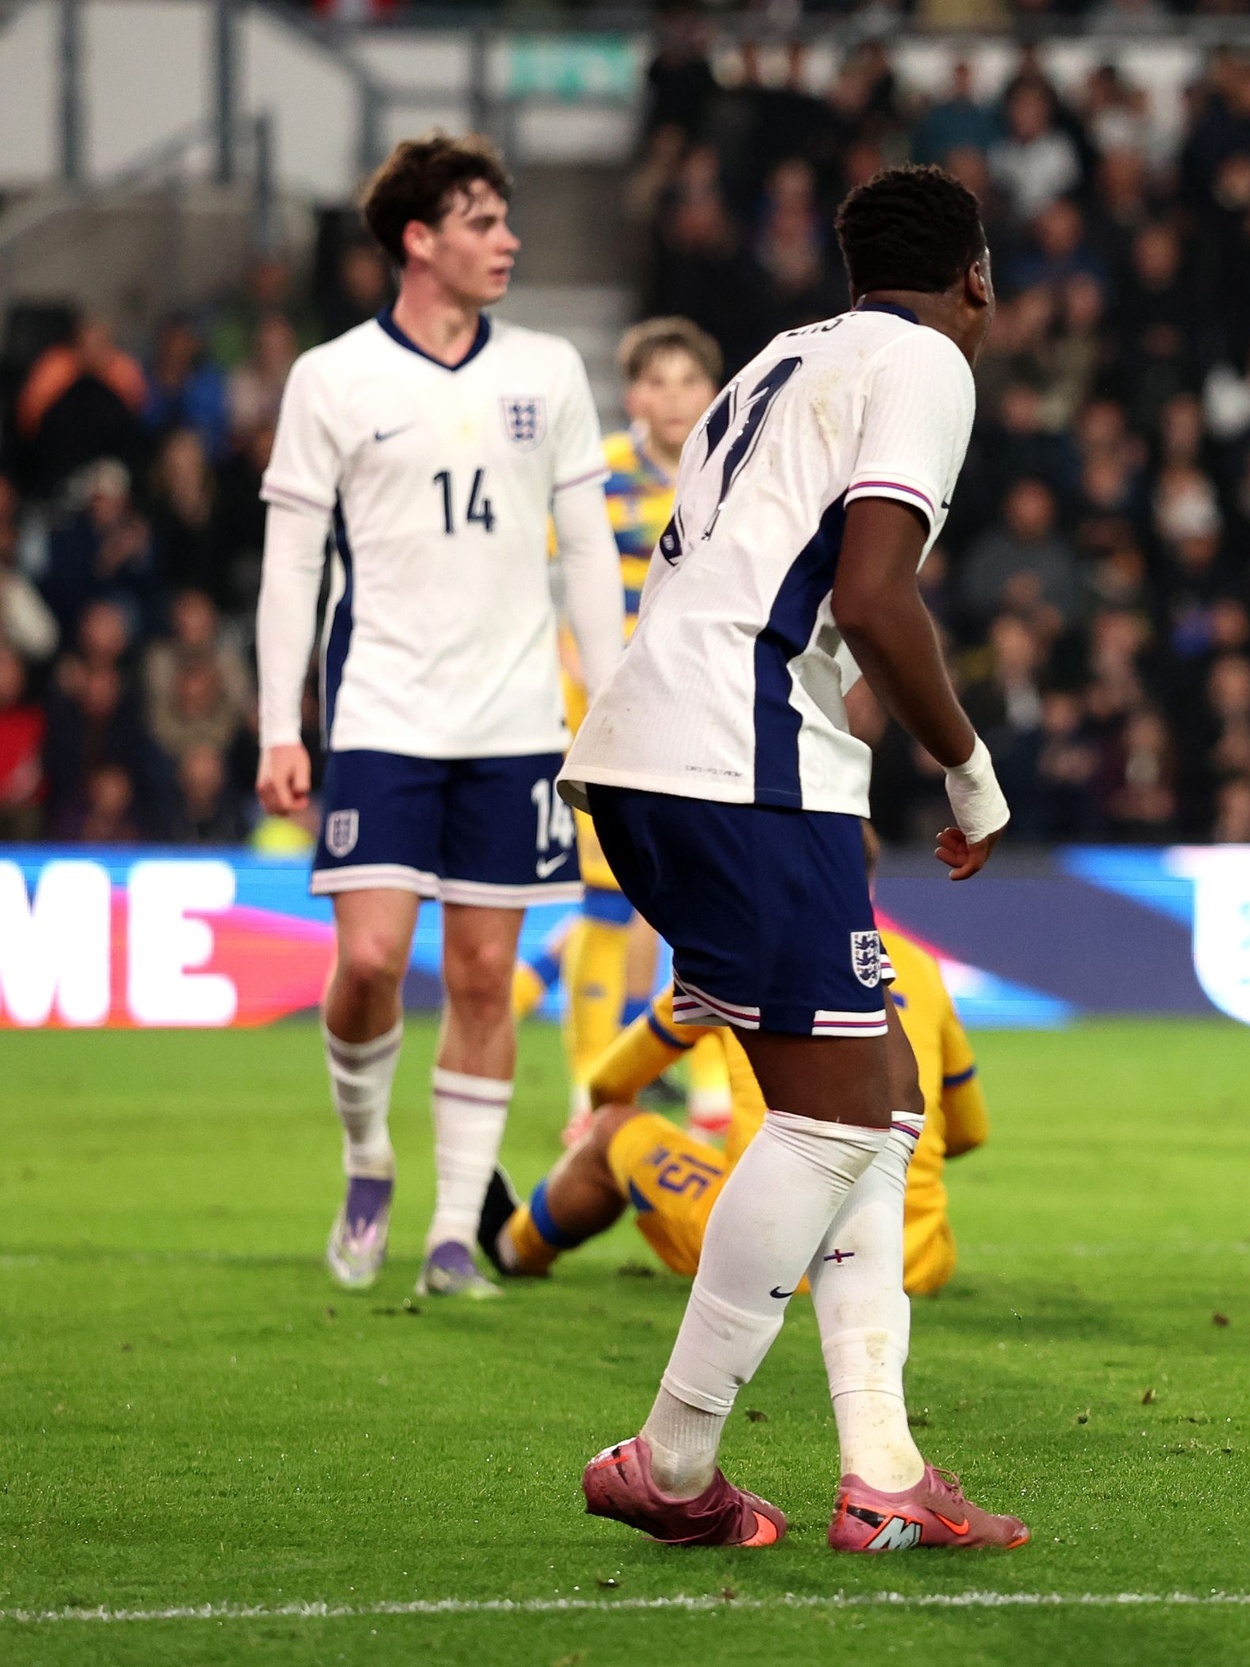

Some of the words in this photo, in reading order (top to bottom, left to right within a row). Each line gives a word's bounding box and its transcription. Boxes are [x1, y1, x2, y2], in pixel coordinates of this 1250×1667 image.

[432, 467, 495, 534] 14
[530, 778, 576, 851] 14
[0, 860, 239, 1028] ME
[657, 1153, 723, 1201] 15
